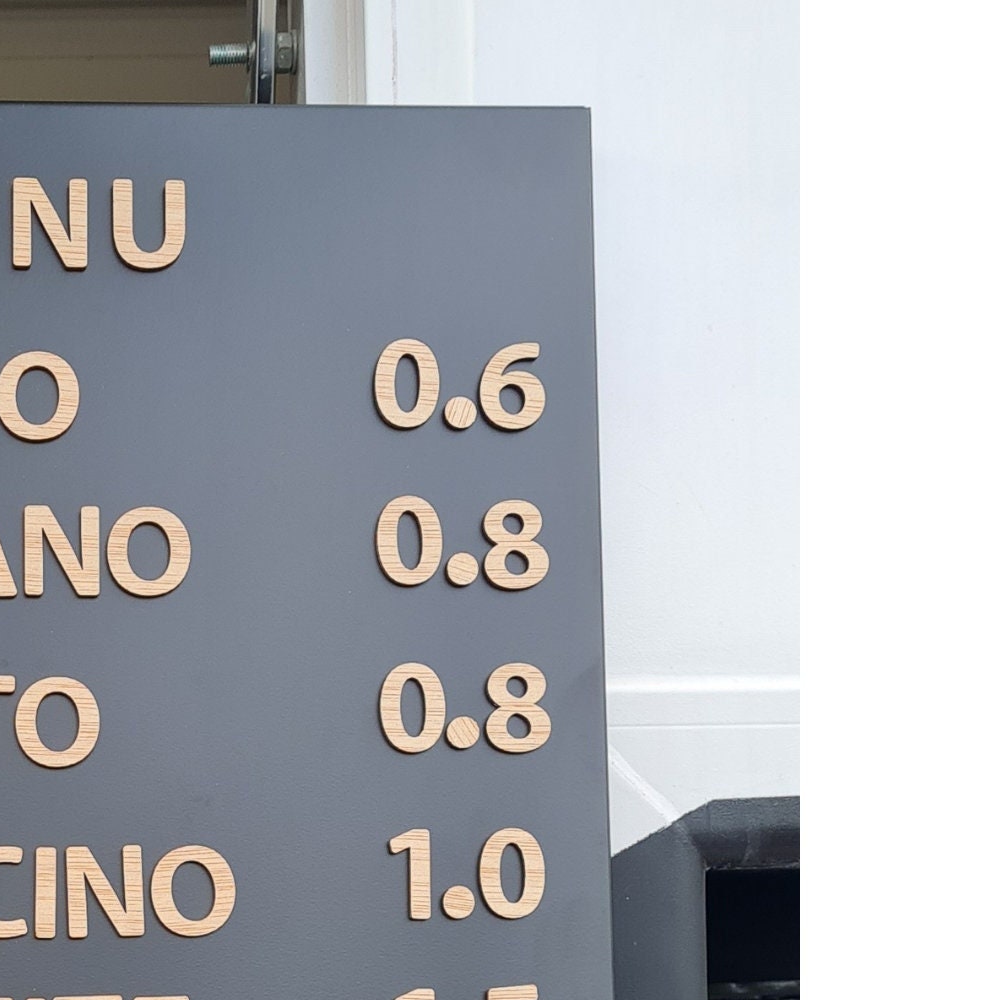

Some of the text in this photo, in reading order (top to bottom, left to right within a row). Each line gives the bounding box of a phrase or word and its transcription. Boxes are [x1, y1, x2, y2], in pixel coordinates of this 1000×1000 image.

[373, 338, 546, 432] 0.6
[375, 495, 551, 591] 0.8
[378, 662, 552, 755] 0.8
[387, 828, 547, 921] 1.0
